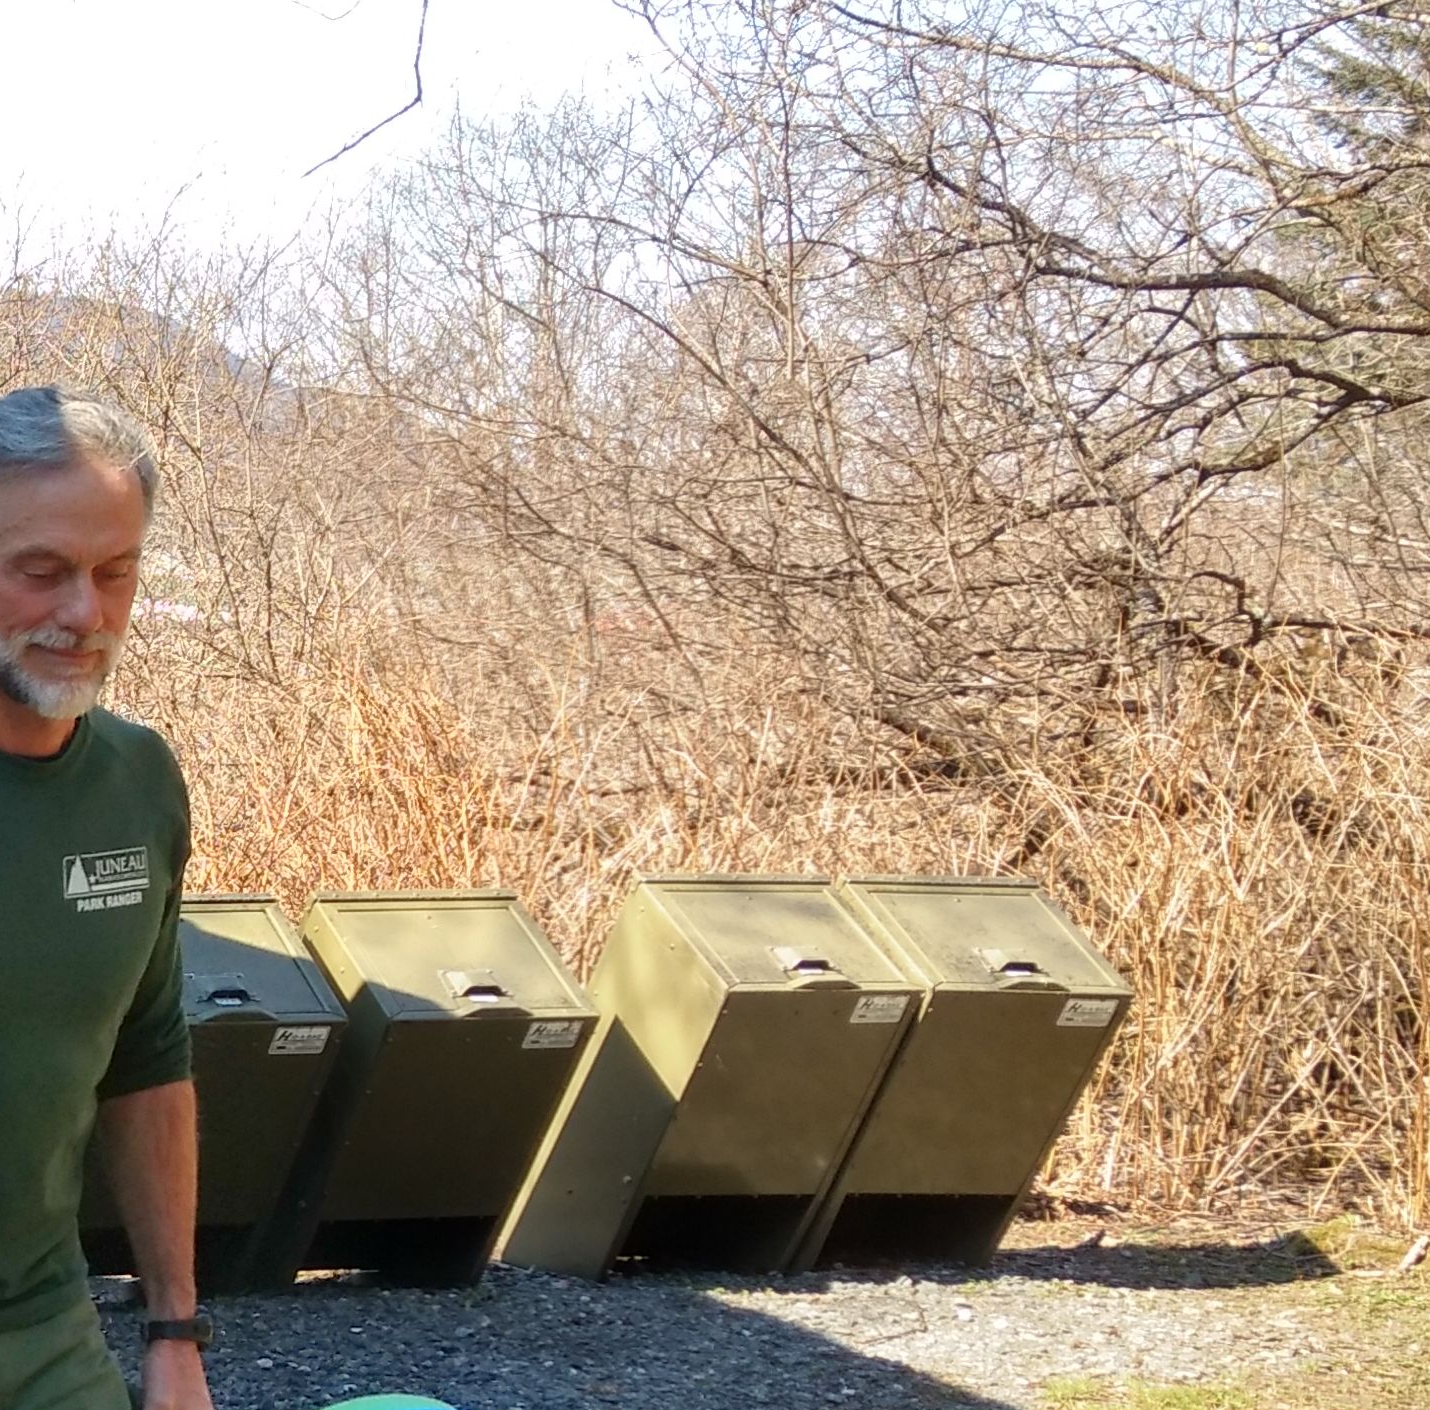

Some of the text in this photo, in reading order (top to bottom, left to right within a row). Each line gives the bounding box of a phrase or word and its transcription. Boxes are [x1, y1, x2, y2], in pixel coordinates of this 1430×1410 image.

[95, 854, 145, 878] JUNEAU
[77, 892, 142, 913] PARK RANGER
